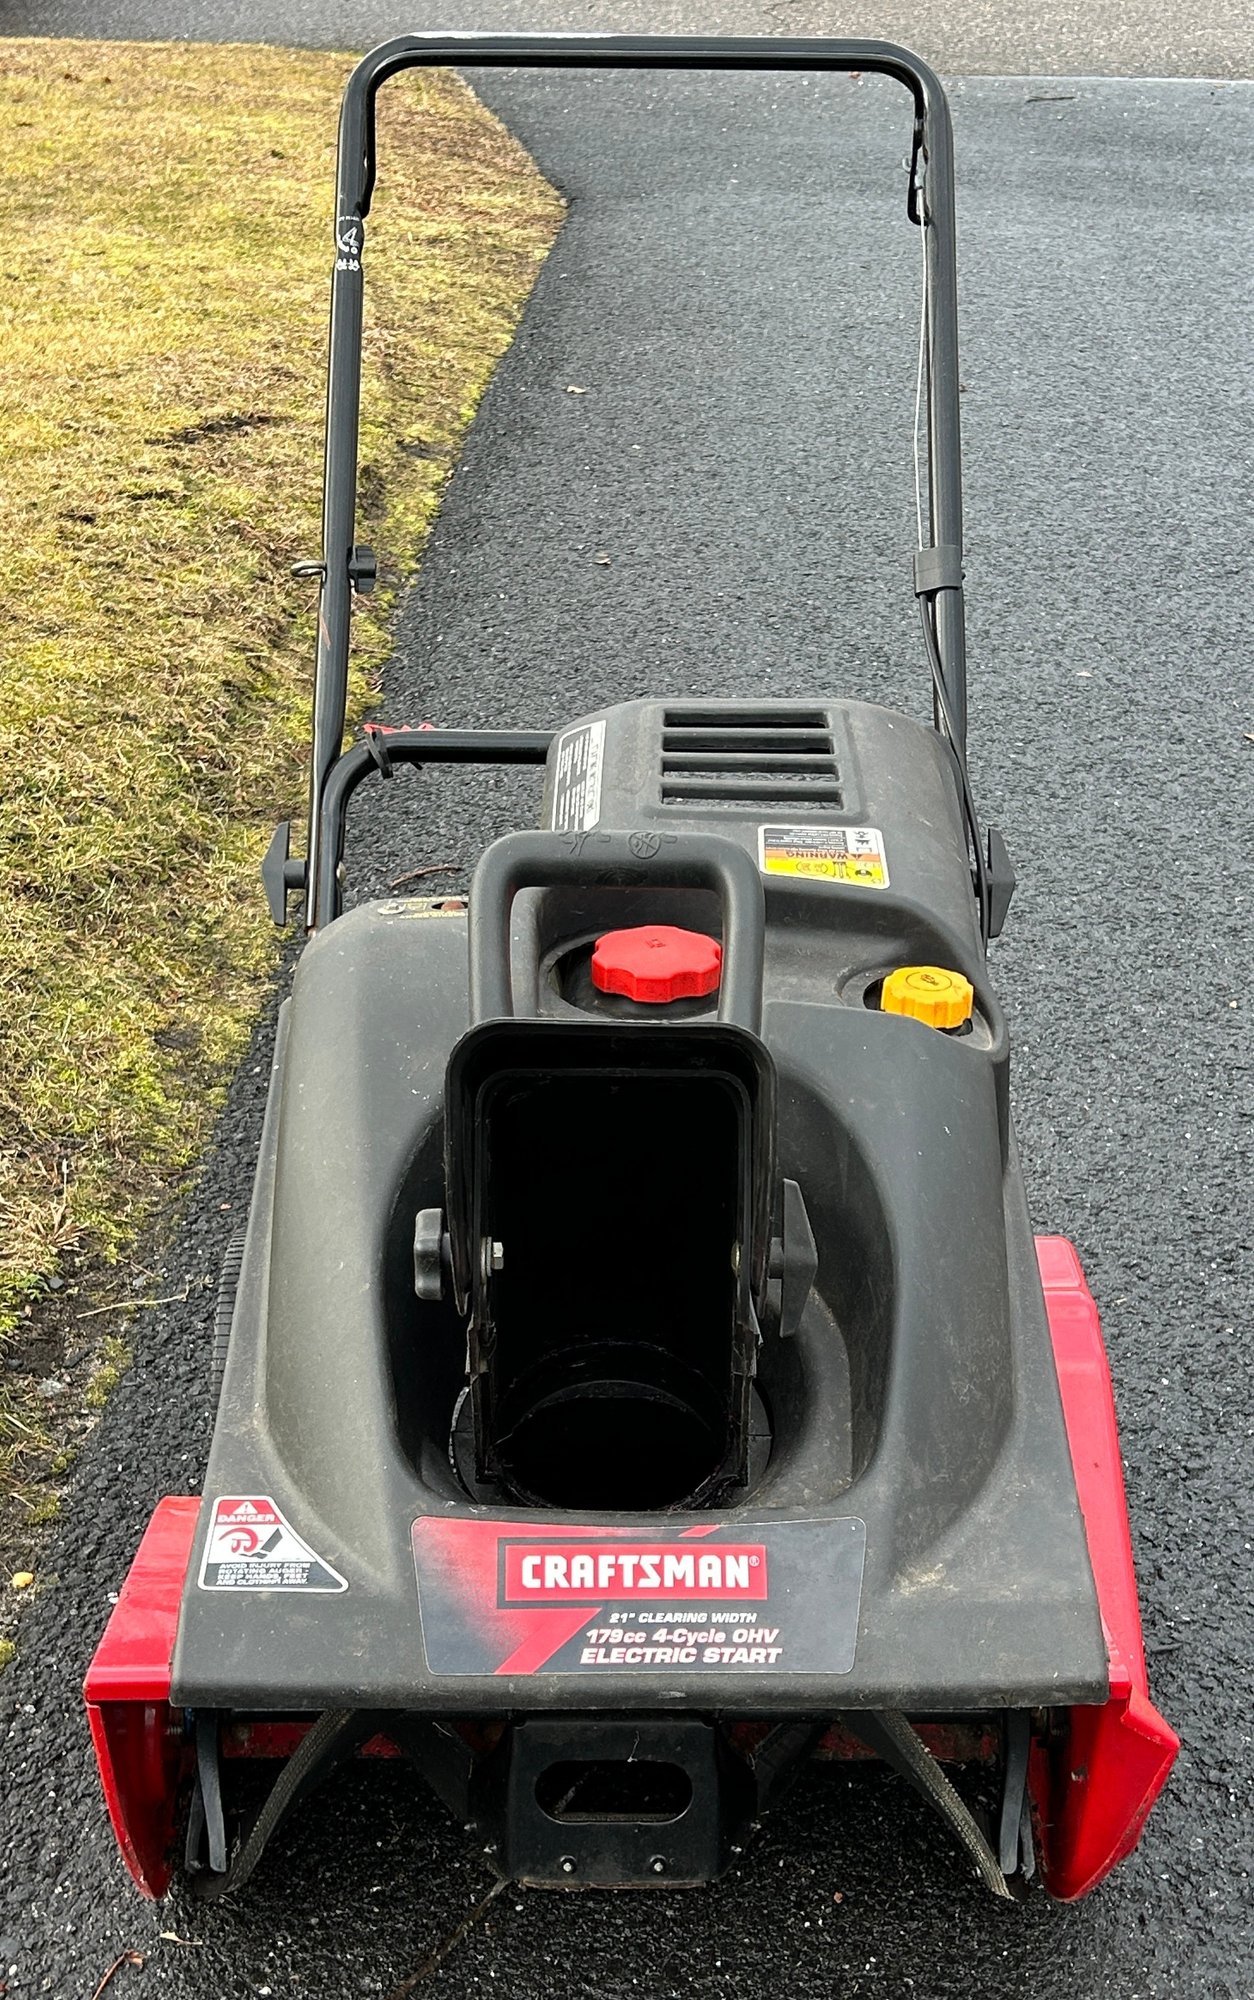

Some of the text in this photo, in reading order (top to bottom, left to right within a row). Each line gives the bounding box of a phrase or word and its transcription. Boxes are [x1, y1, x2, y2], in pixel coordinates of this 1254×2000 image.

[785, 850, 848, 860] WARNING
[217, 1514, 275, 1523] DANGER
[609, 1612, 758, 1624] 21" CLEARING WIDTH
[586, 1628, 780, 1646] 179cc 4-Cycle OHV
[579, 1647, 783, 1664] ELECTRIC START
